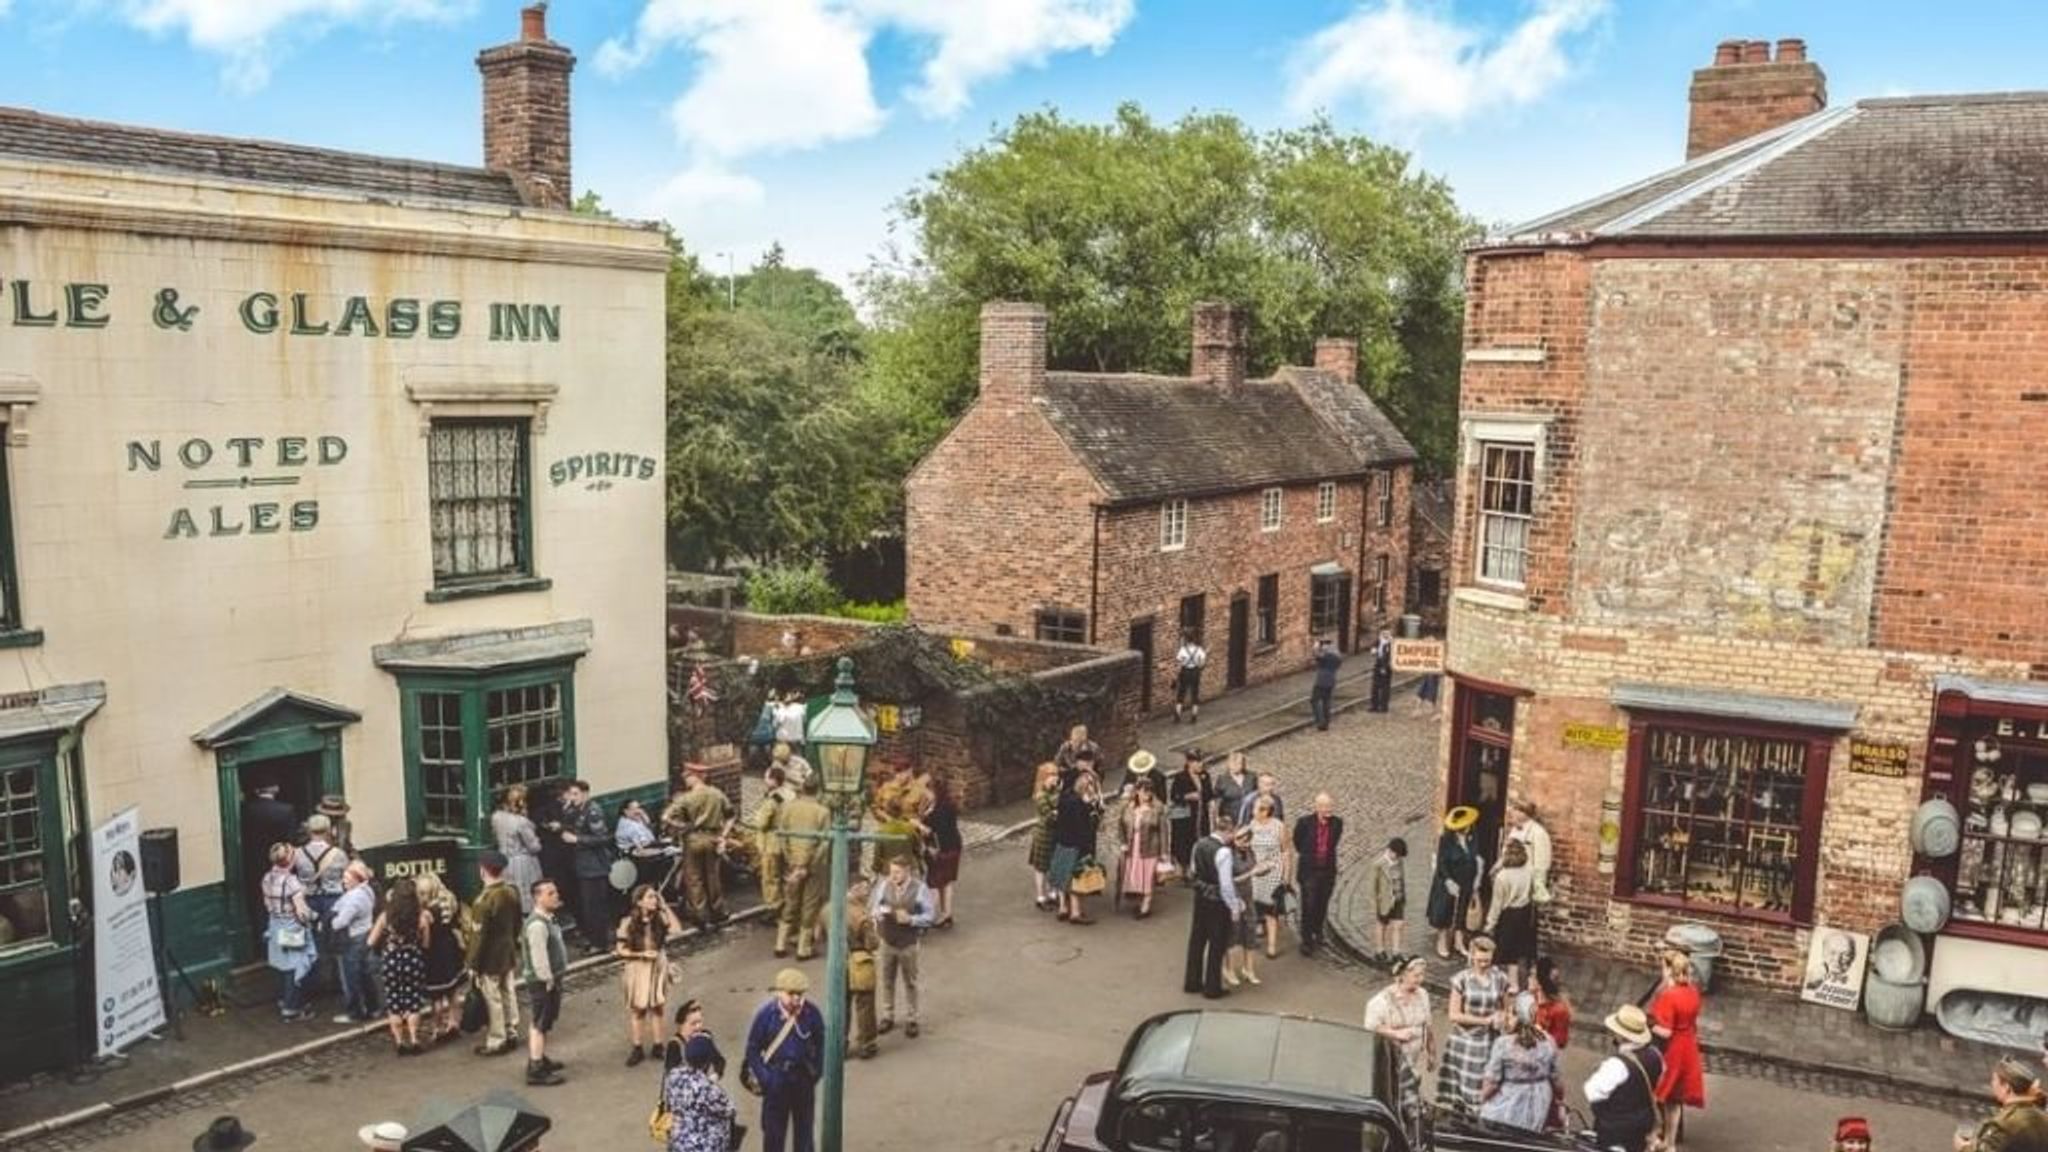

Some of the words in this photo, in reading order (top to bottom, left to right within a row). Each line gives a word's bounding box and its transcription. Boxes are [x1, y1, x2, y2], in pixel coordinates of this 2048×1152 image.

[0, 279, 111, 328] LE
[152, 288, 200, 332] &
[239, 292, 462, 339] GLASS
[488, 303, 561, 342] INN
[127, 436, 348, 471] NOTED
[549, 452, 656, 486] SPIRITS
[163, 501, 319, 539] ALES
[1853, 744, 1908, 761] BRASSO
[385, 858, 447, 878] BOTTLE
